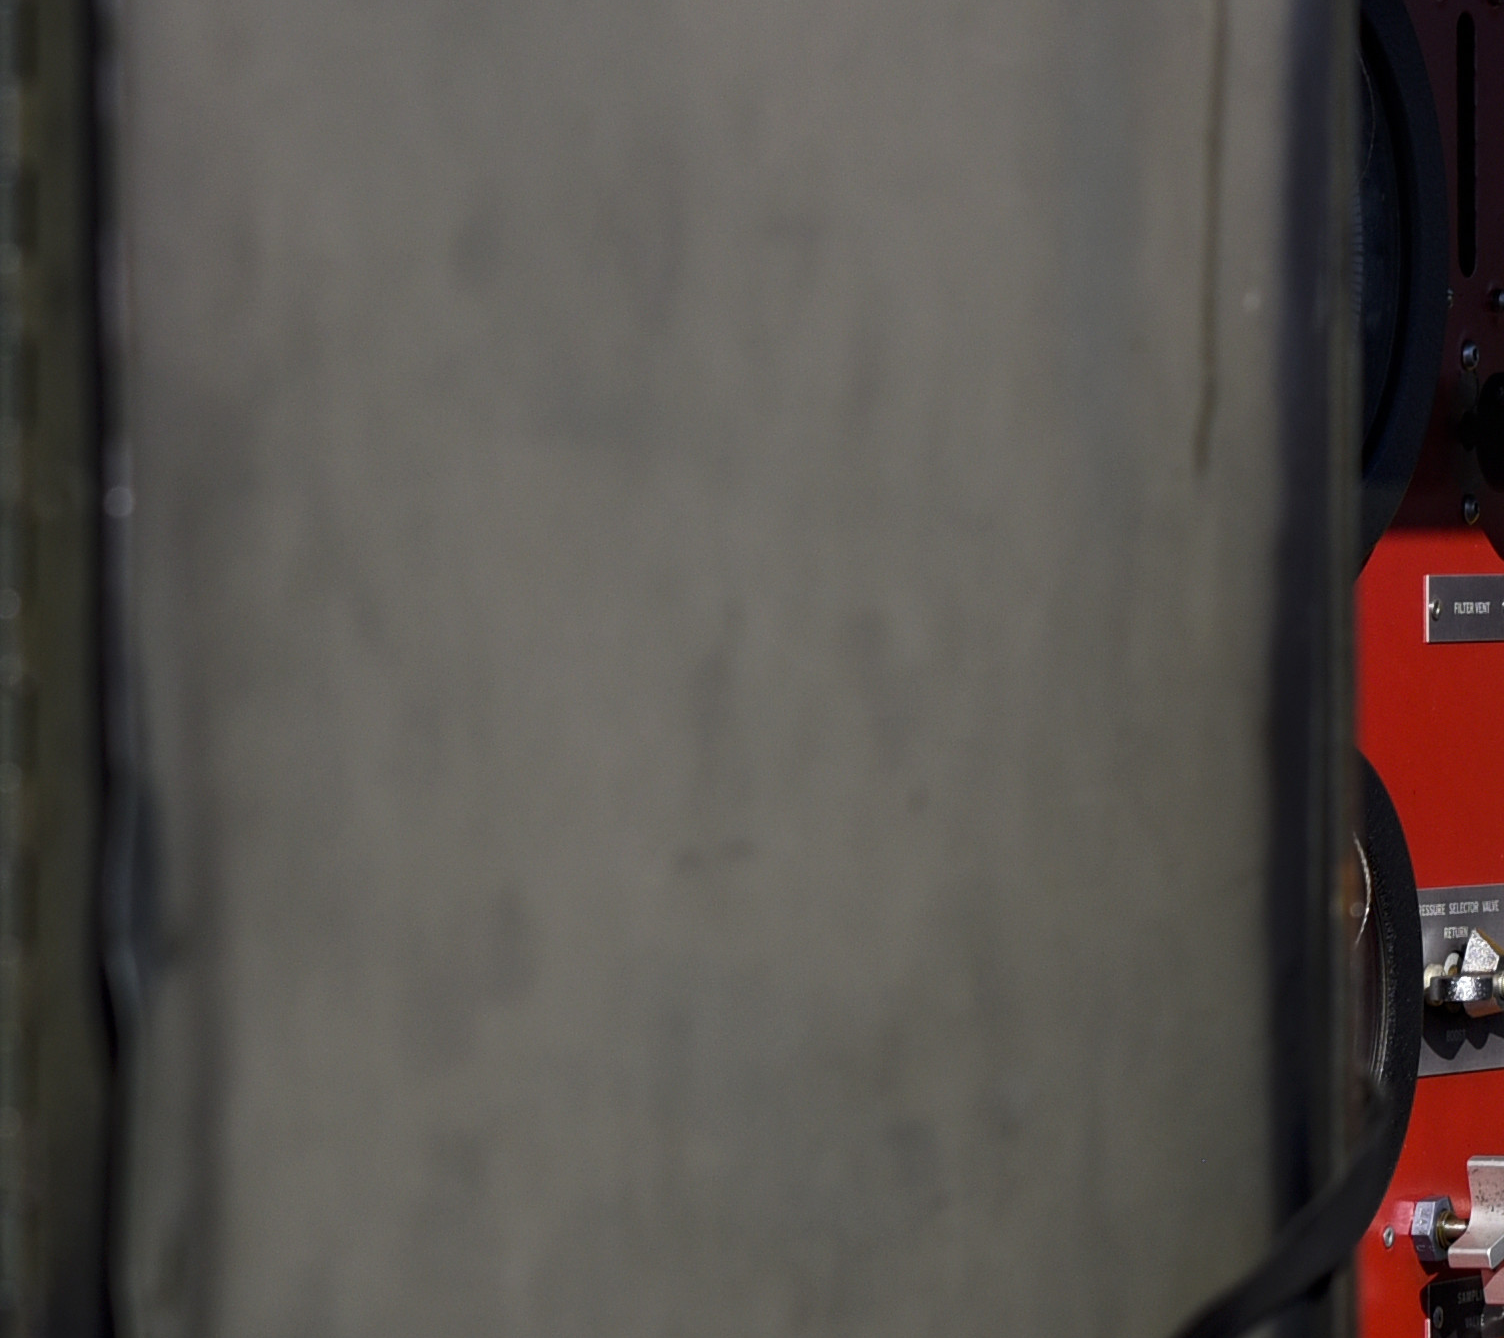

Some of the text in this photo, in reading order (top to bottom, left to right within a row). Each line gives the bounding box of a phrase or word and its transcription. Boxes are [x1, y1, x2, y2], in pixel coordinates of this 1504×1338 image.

[1453, 601, 1491, 615] FILTER VENT
[1419, 899, 1500, 917] RESSURE SELECTOR VALVE
[1443, 925, 1469, 940] RETURN
